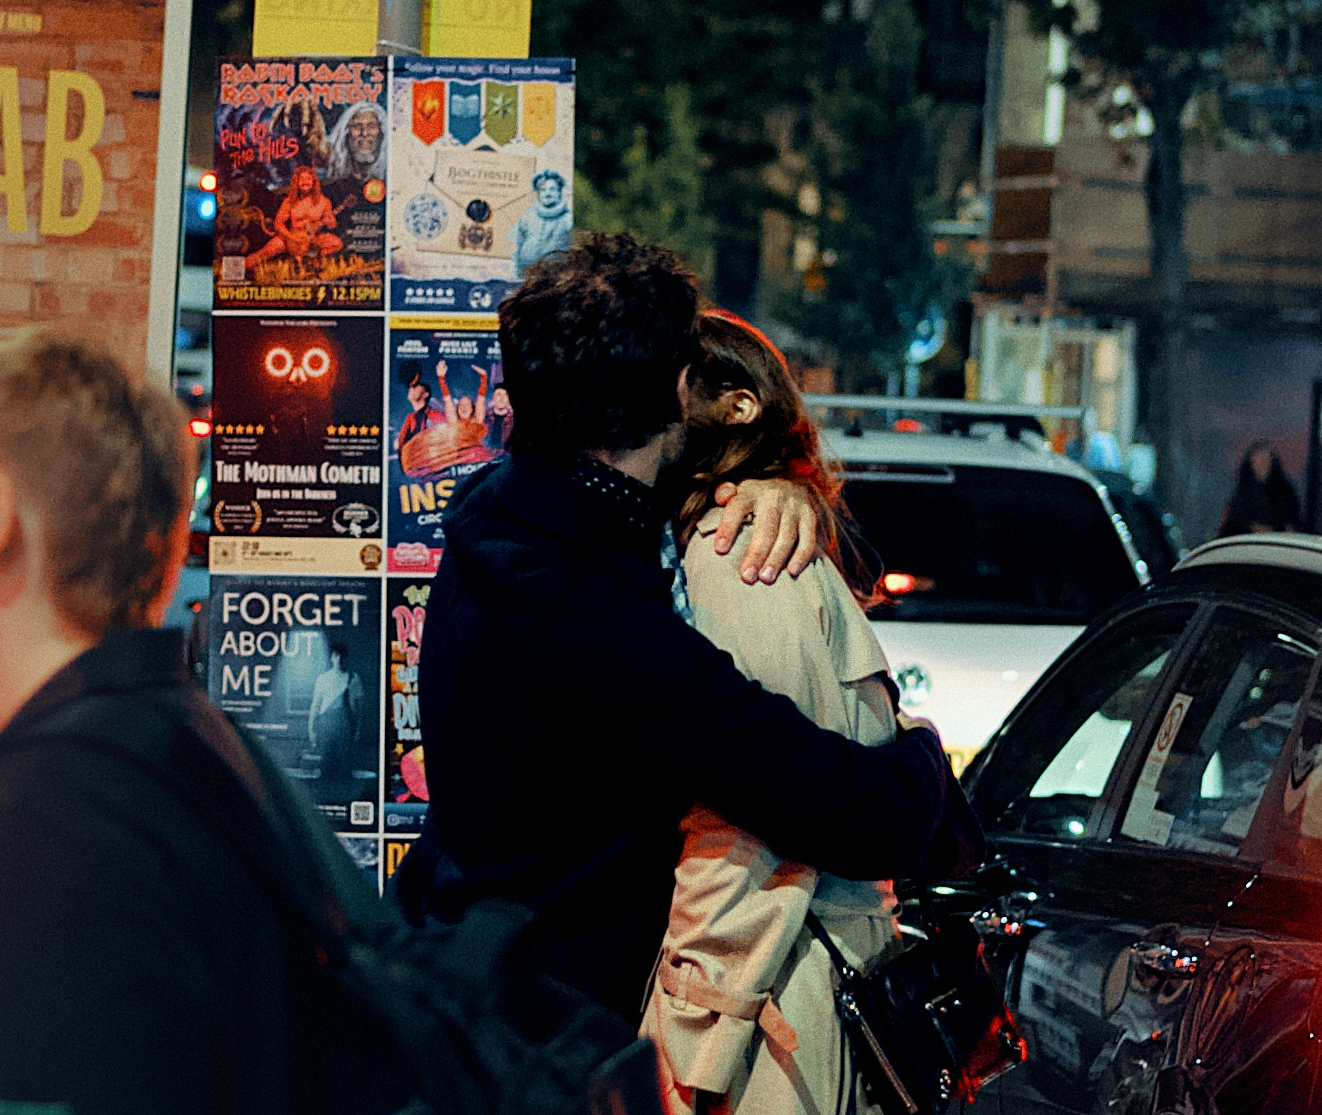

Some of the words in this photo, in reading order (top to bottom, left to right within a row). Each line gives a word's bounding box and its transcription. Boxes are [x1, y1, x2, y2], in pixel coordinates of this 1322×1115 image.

[222, 592, 367, 626] FORGET
[219, 630, 319, 657] ABOUT
[221, 665, 273, 697] ME
